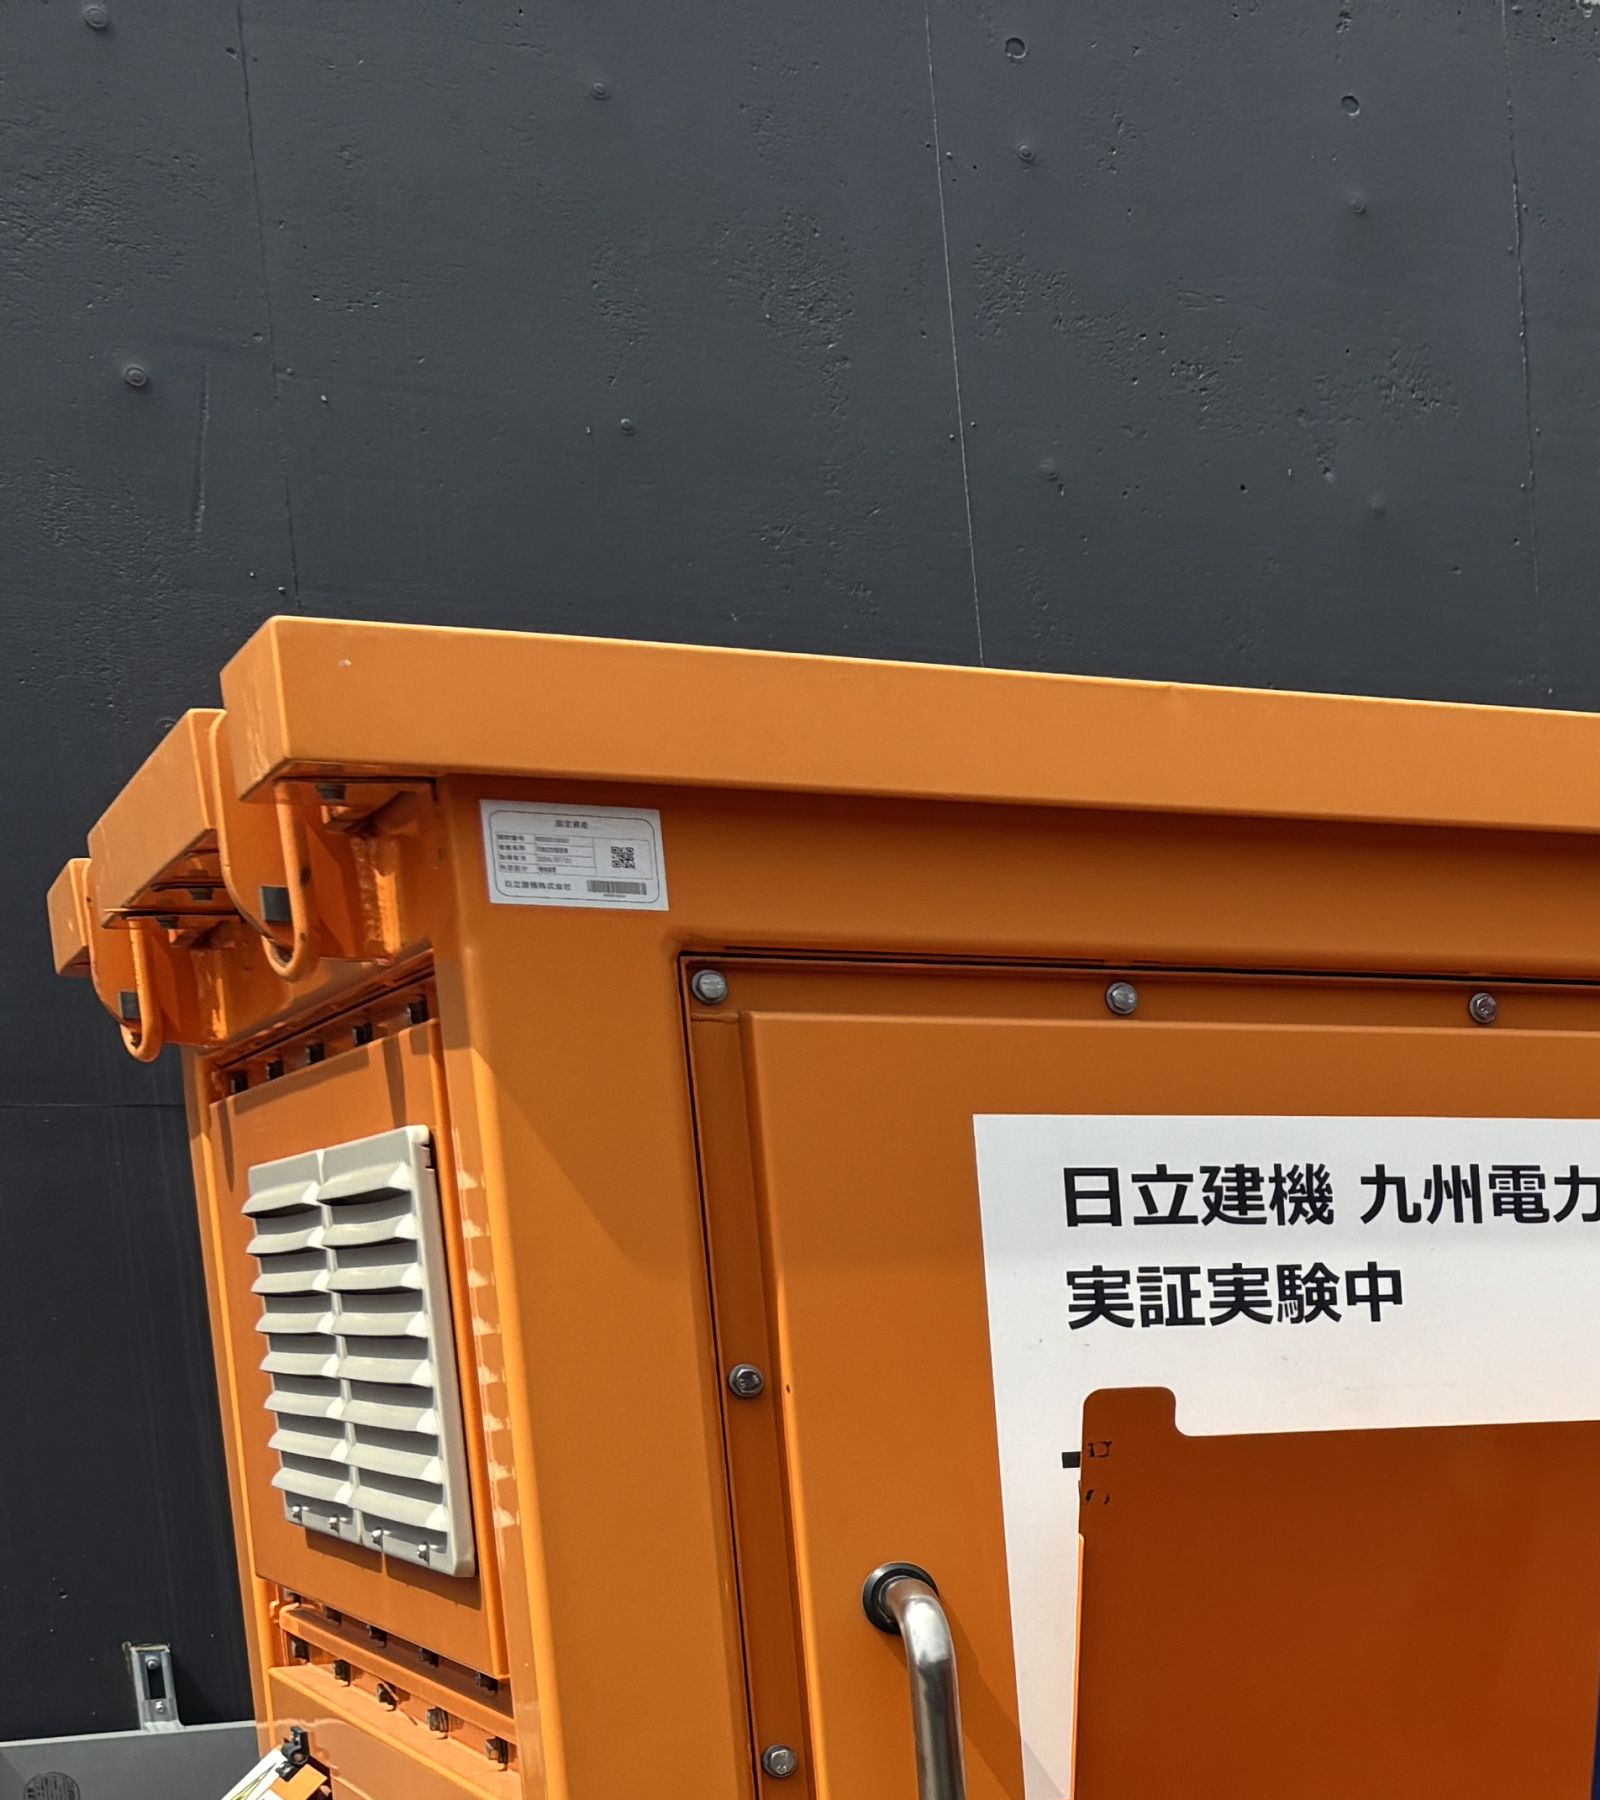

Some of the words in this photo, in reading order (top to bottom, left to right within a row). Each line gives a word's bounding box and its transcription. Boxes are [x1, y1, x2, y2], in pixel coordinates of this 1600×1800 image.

[1064, 1164, 1334, 1227] 日立建機
[1067, 1262, 1403, 1330] 実証実験中
